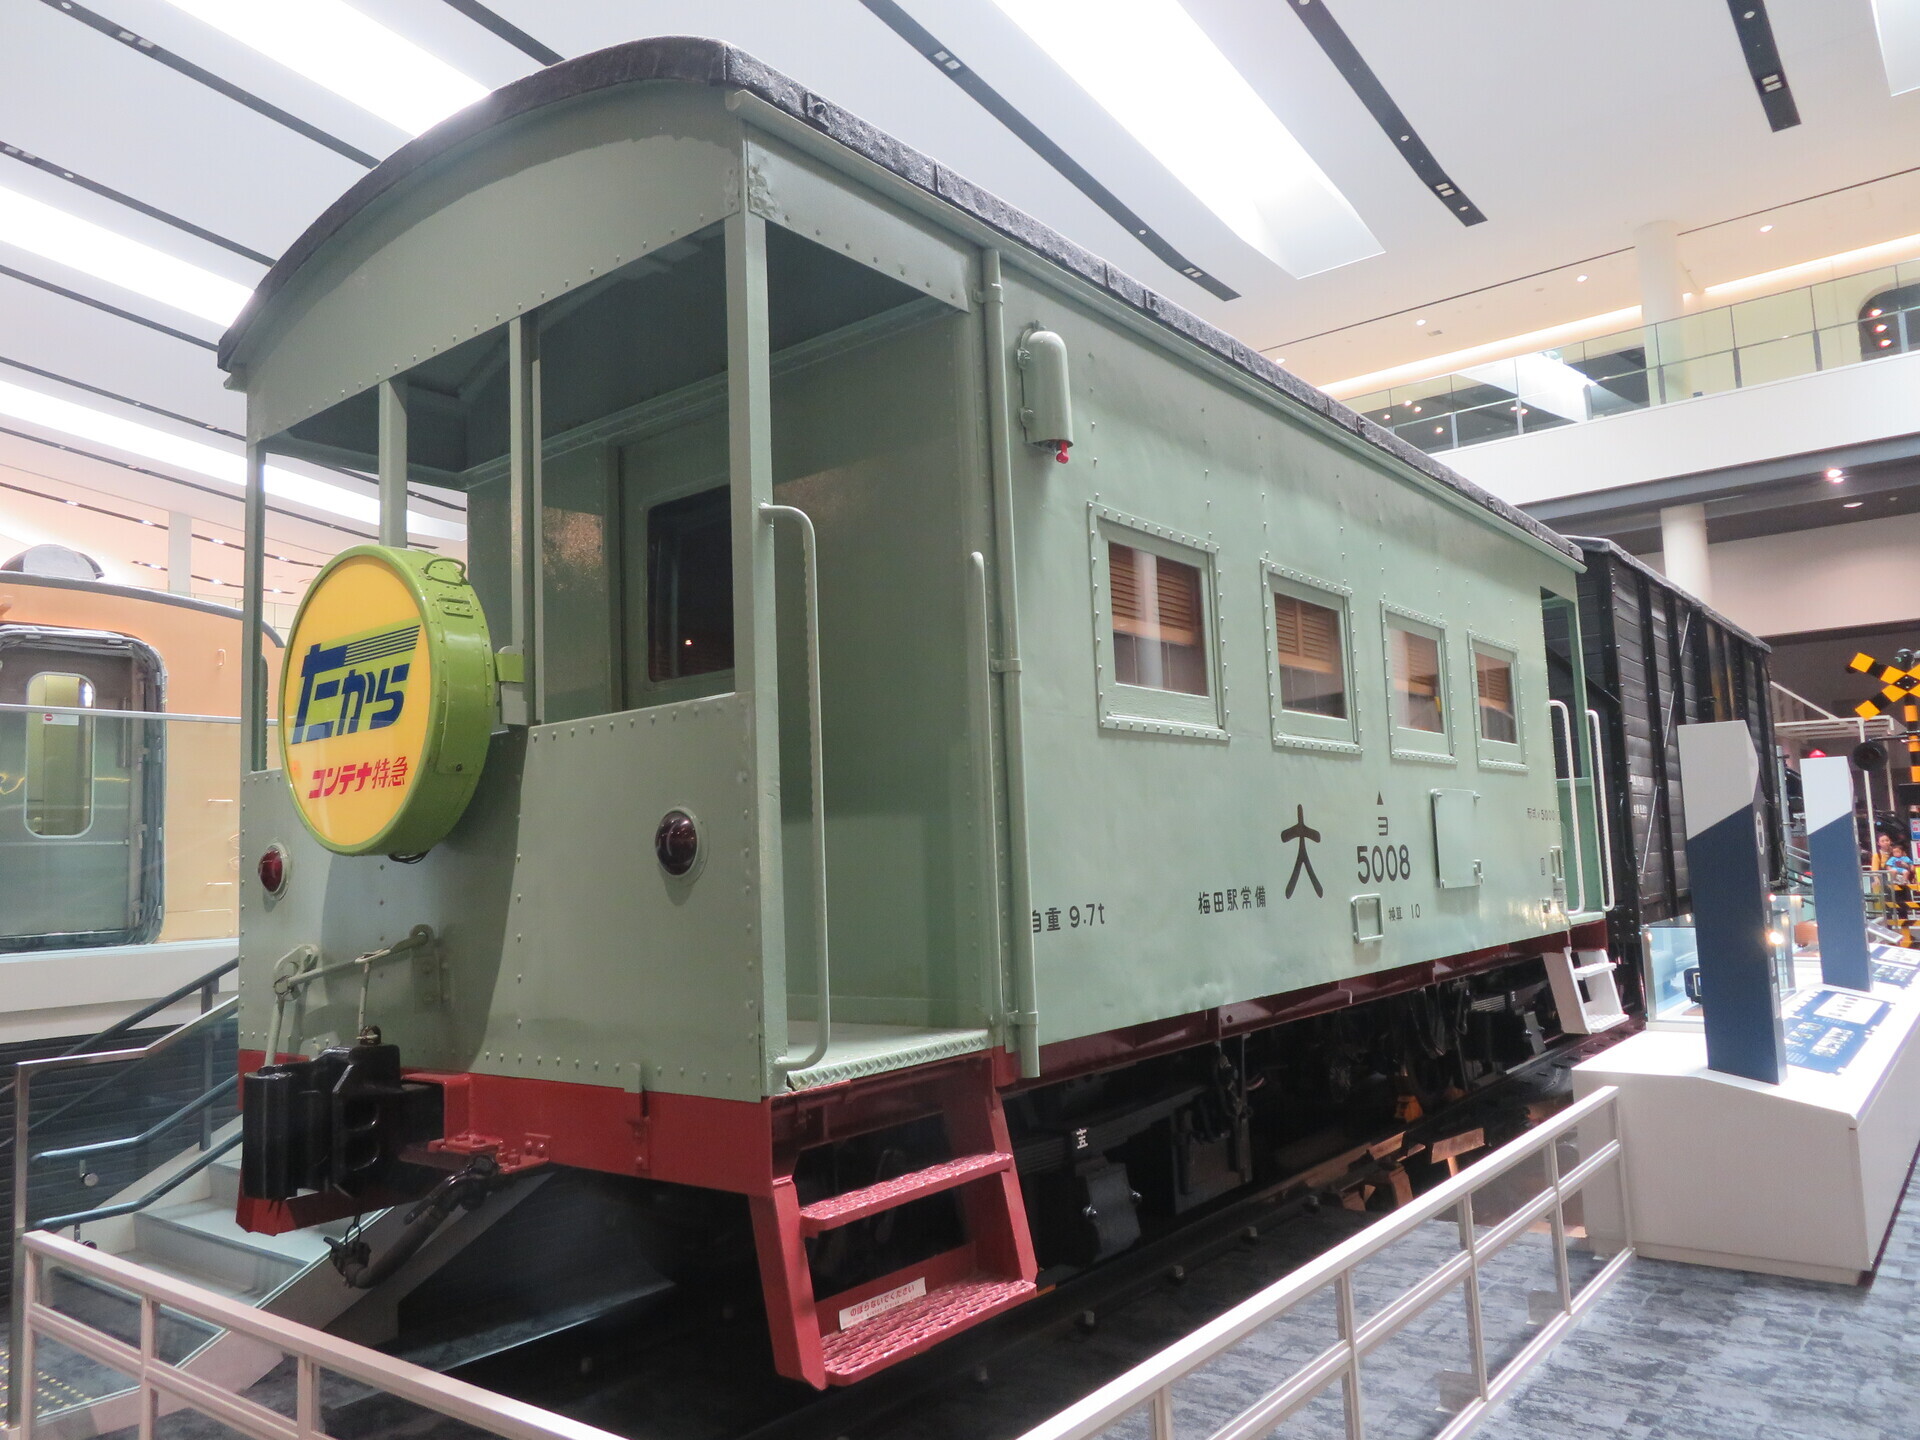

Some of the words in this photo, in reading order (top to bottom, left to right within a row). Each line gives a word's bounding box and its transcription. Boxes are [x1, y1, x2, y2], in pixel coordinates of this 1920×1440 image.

[291, 624, 421, 745] たから
[308, 756, 408, 799] コンテナ特急
[1280, 803, 1324, 900] 大
[1356, 844, 1411, 885] 5008
[1069, 902, 1105, 929] 9.7t
[1197, 885, 1267, 915] 梅田駅常備
